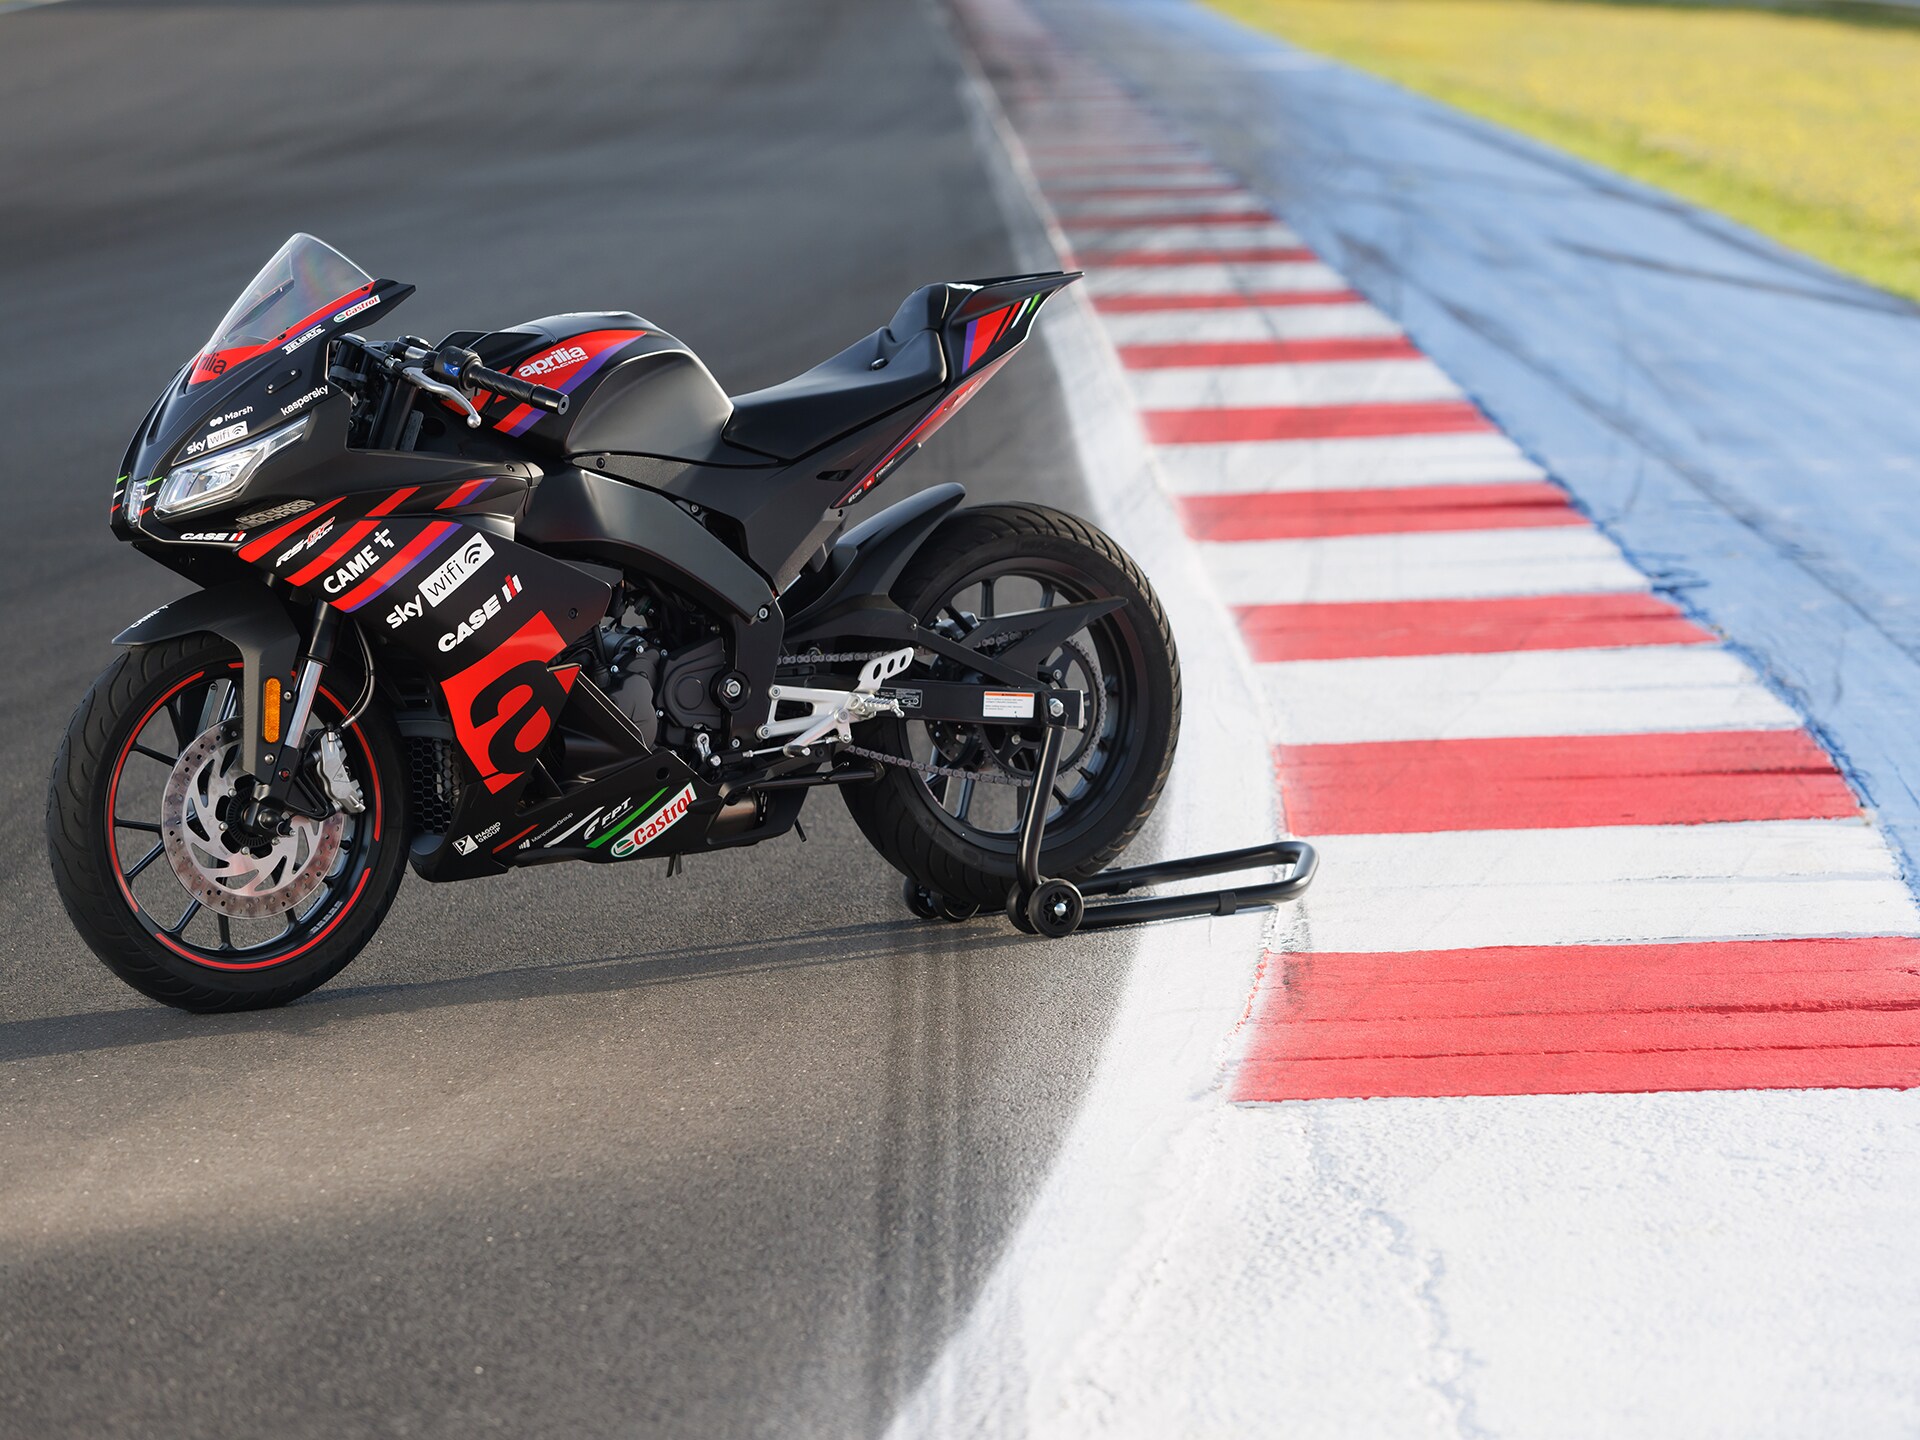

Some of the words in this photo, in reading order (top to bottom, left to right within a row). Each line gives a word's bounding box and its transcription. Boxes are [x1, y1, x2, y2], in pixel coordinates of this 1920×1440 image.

[344, 296, 379, 318] Castrol
[518, 345, 587, 378] aprilia
[543, 355, 589, 374] RACING
[224, 405, 253, 422] Marsh
[280, 384, 329, 416] kaspersky
[186, 439, 207, 455] sky
[209, 427, 231, 444] wifi
[180, 532, 229, 541] CASE
[323, 545, 380, 594] CAME
[386, 594, 424, 629] sky
[427, 559, 465, 598] wifi
[437, 594, 502, 653] CASE
[601, 796, 632, 827] FPT
[633, 788, 693, 846] Castrol
[474, 821, 502, 839] PIAGGIO
[477, 826, 501, 843] GROUP
[530, 812, 574, 843] ManpowerGroup
